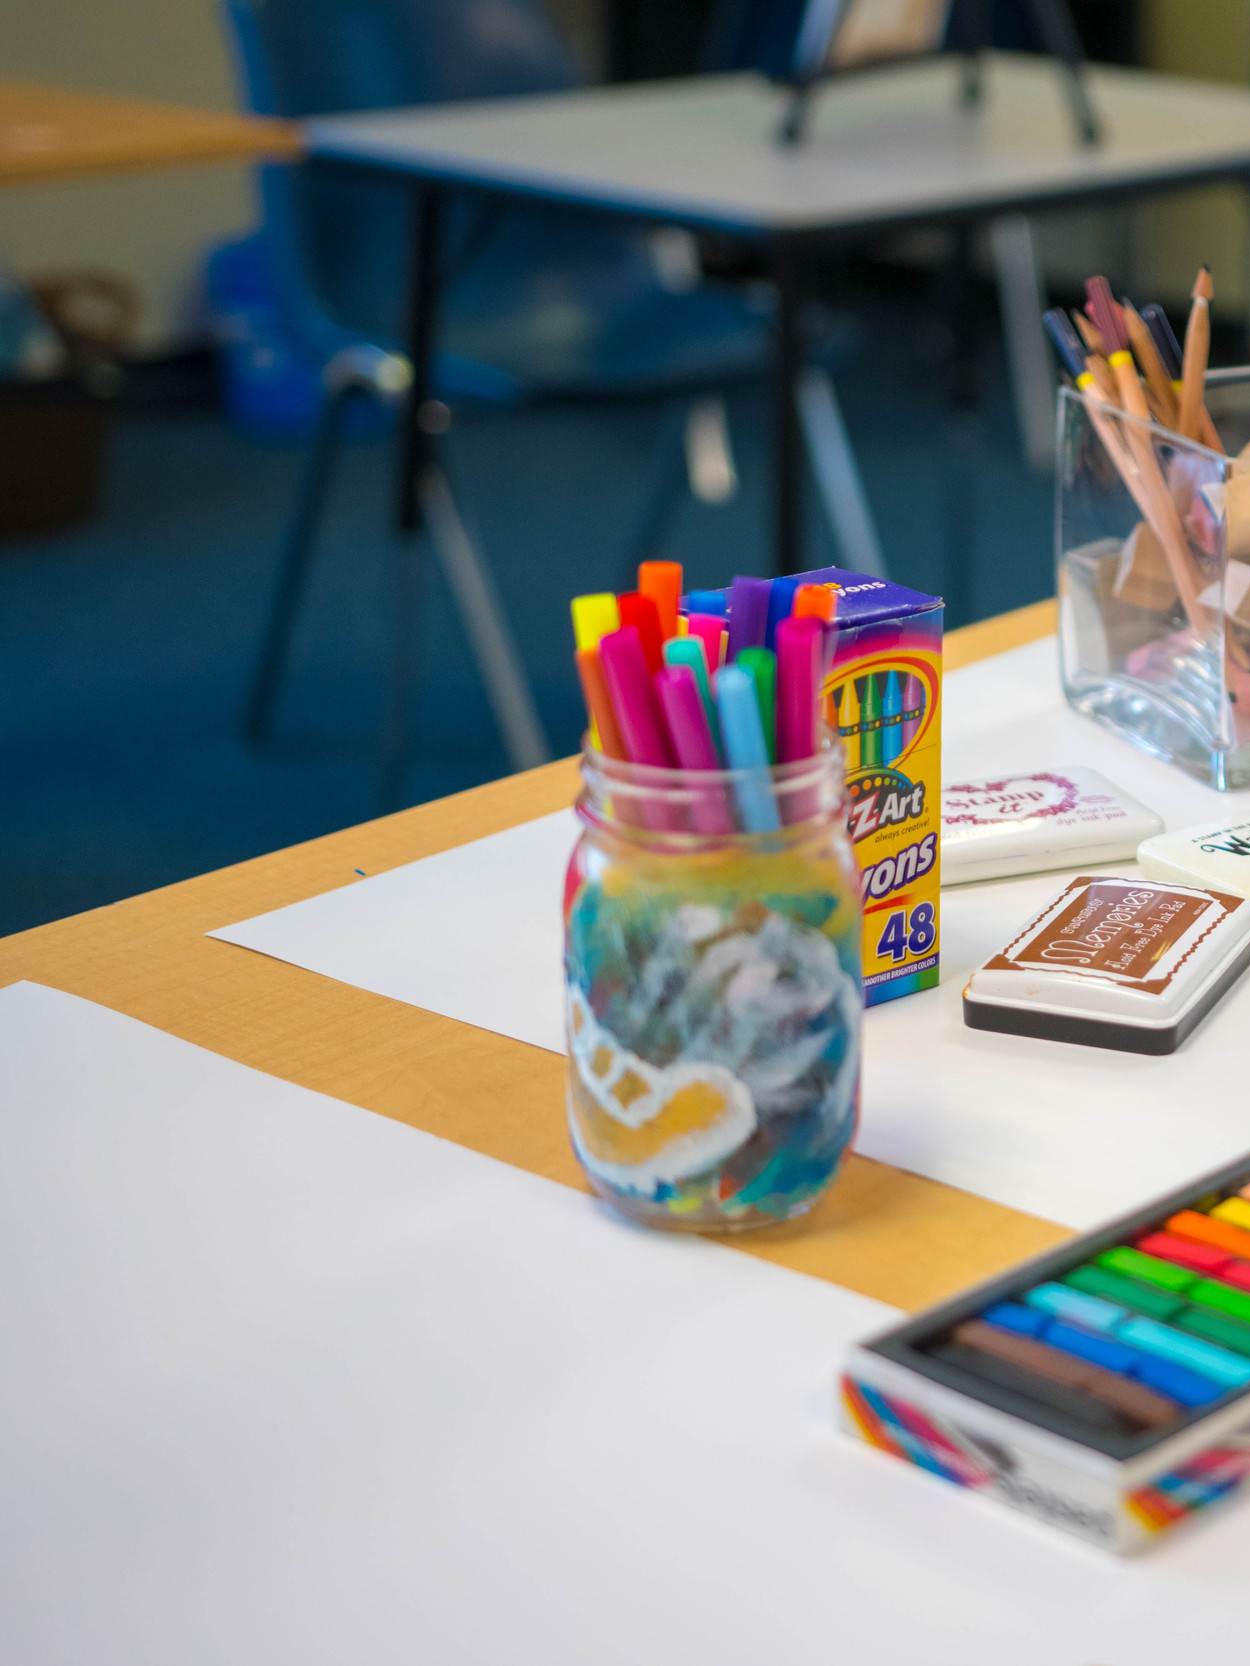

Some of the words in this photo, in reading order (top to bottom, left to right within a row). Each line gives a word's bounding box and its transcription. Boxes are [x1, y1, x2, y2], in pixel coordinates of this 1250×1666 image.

[945, 791, 1044, 809] Stamp
[999, 802, 1024, 814] it
[874, 829, 900, 843] always
[901, 817, 930, 835] creative!
[1158, 900, 1187, 913] Pad
[1041, 890, 1154, 963] Memories
[1147, 911, 1175, 924] Ink
[876, 901, 936, 962] 48
[1133, 923, 1164, 938] Dye
[1119, 937, 1151, 953] Free
[1104, 952, 1137, 970] Acid
[861, 972, 890, 986] SMOOTHER
[891, 963, 917, 978] BRIGHTER
[917, 956, 936, 969] COLORS
